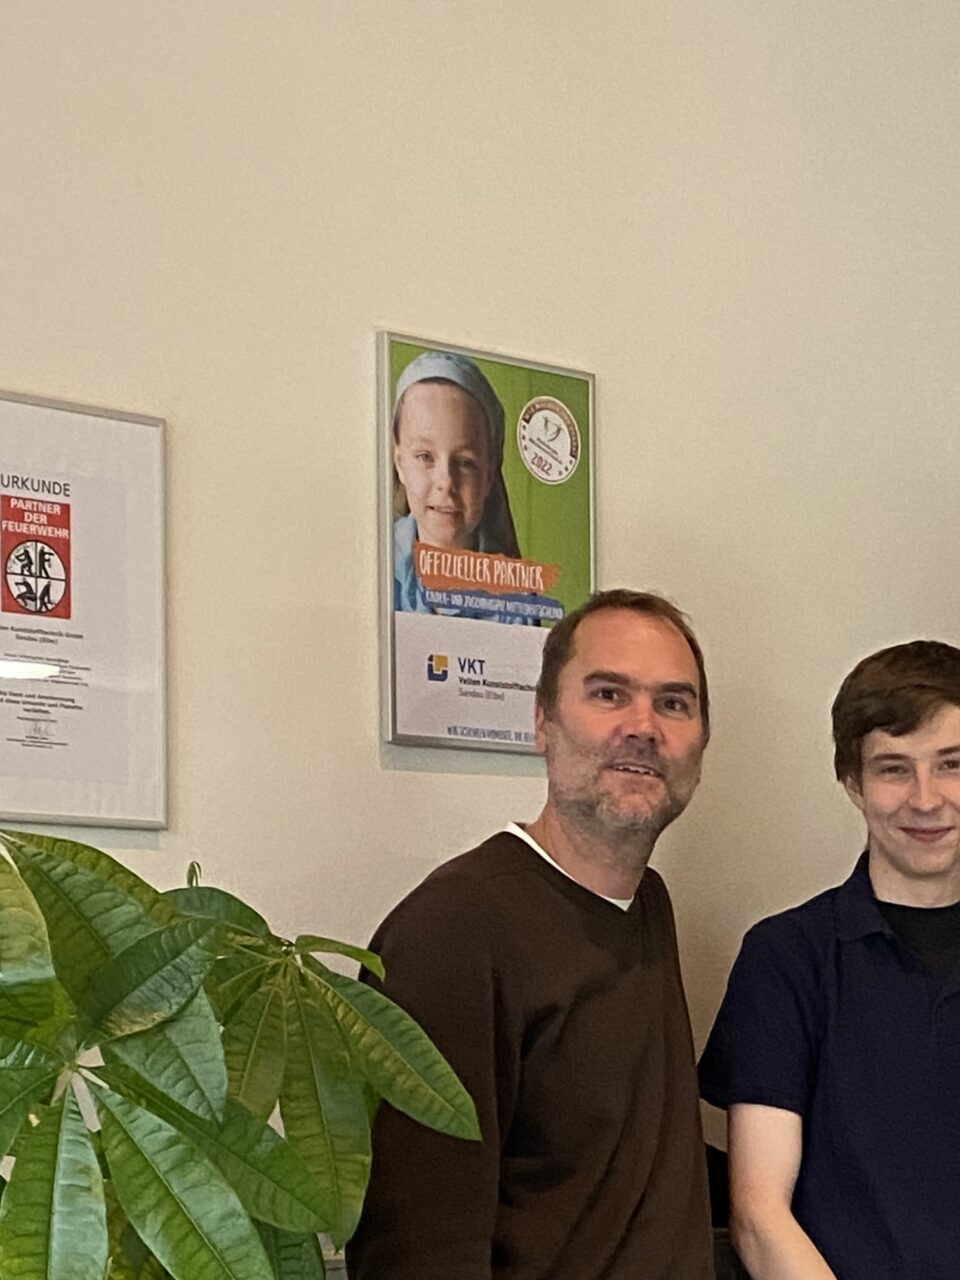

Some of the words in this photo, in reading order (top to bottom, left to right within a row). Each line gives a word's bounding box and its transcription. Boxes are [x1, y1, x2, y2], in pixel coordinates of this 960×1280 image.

[531, 453, 553, 476] 2022
[0, 474, 71, 498] URKUNDE
[10, 498, 61, 515] PARTNER
[24, 512, 48, 524] DER
[1, 520, 69, 539] FEUERWEHR
[419, 549, 491, 584] OFFIZIELLER
[493, 559, 544, 591] PARTNER
[458, 657, 486, 675] VKT
